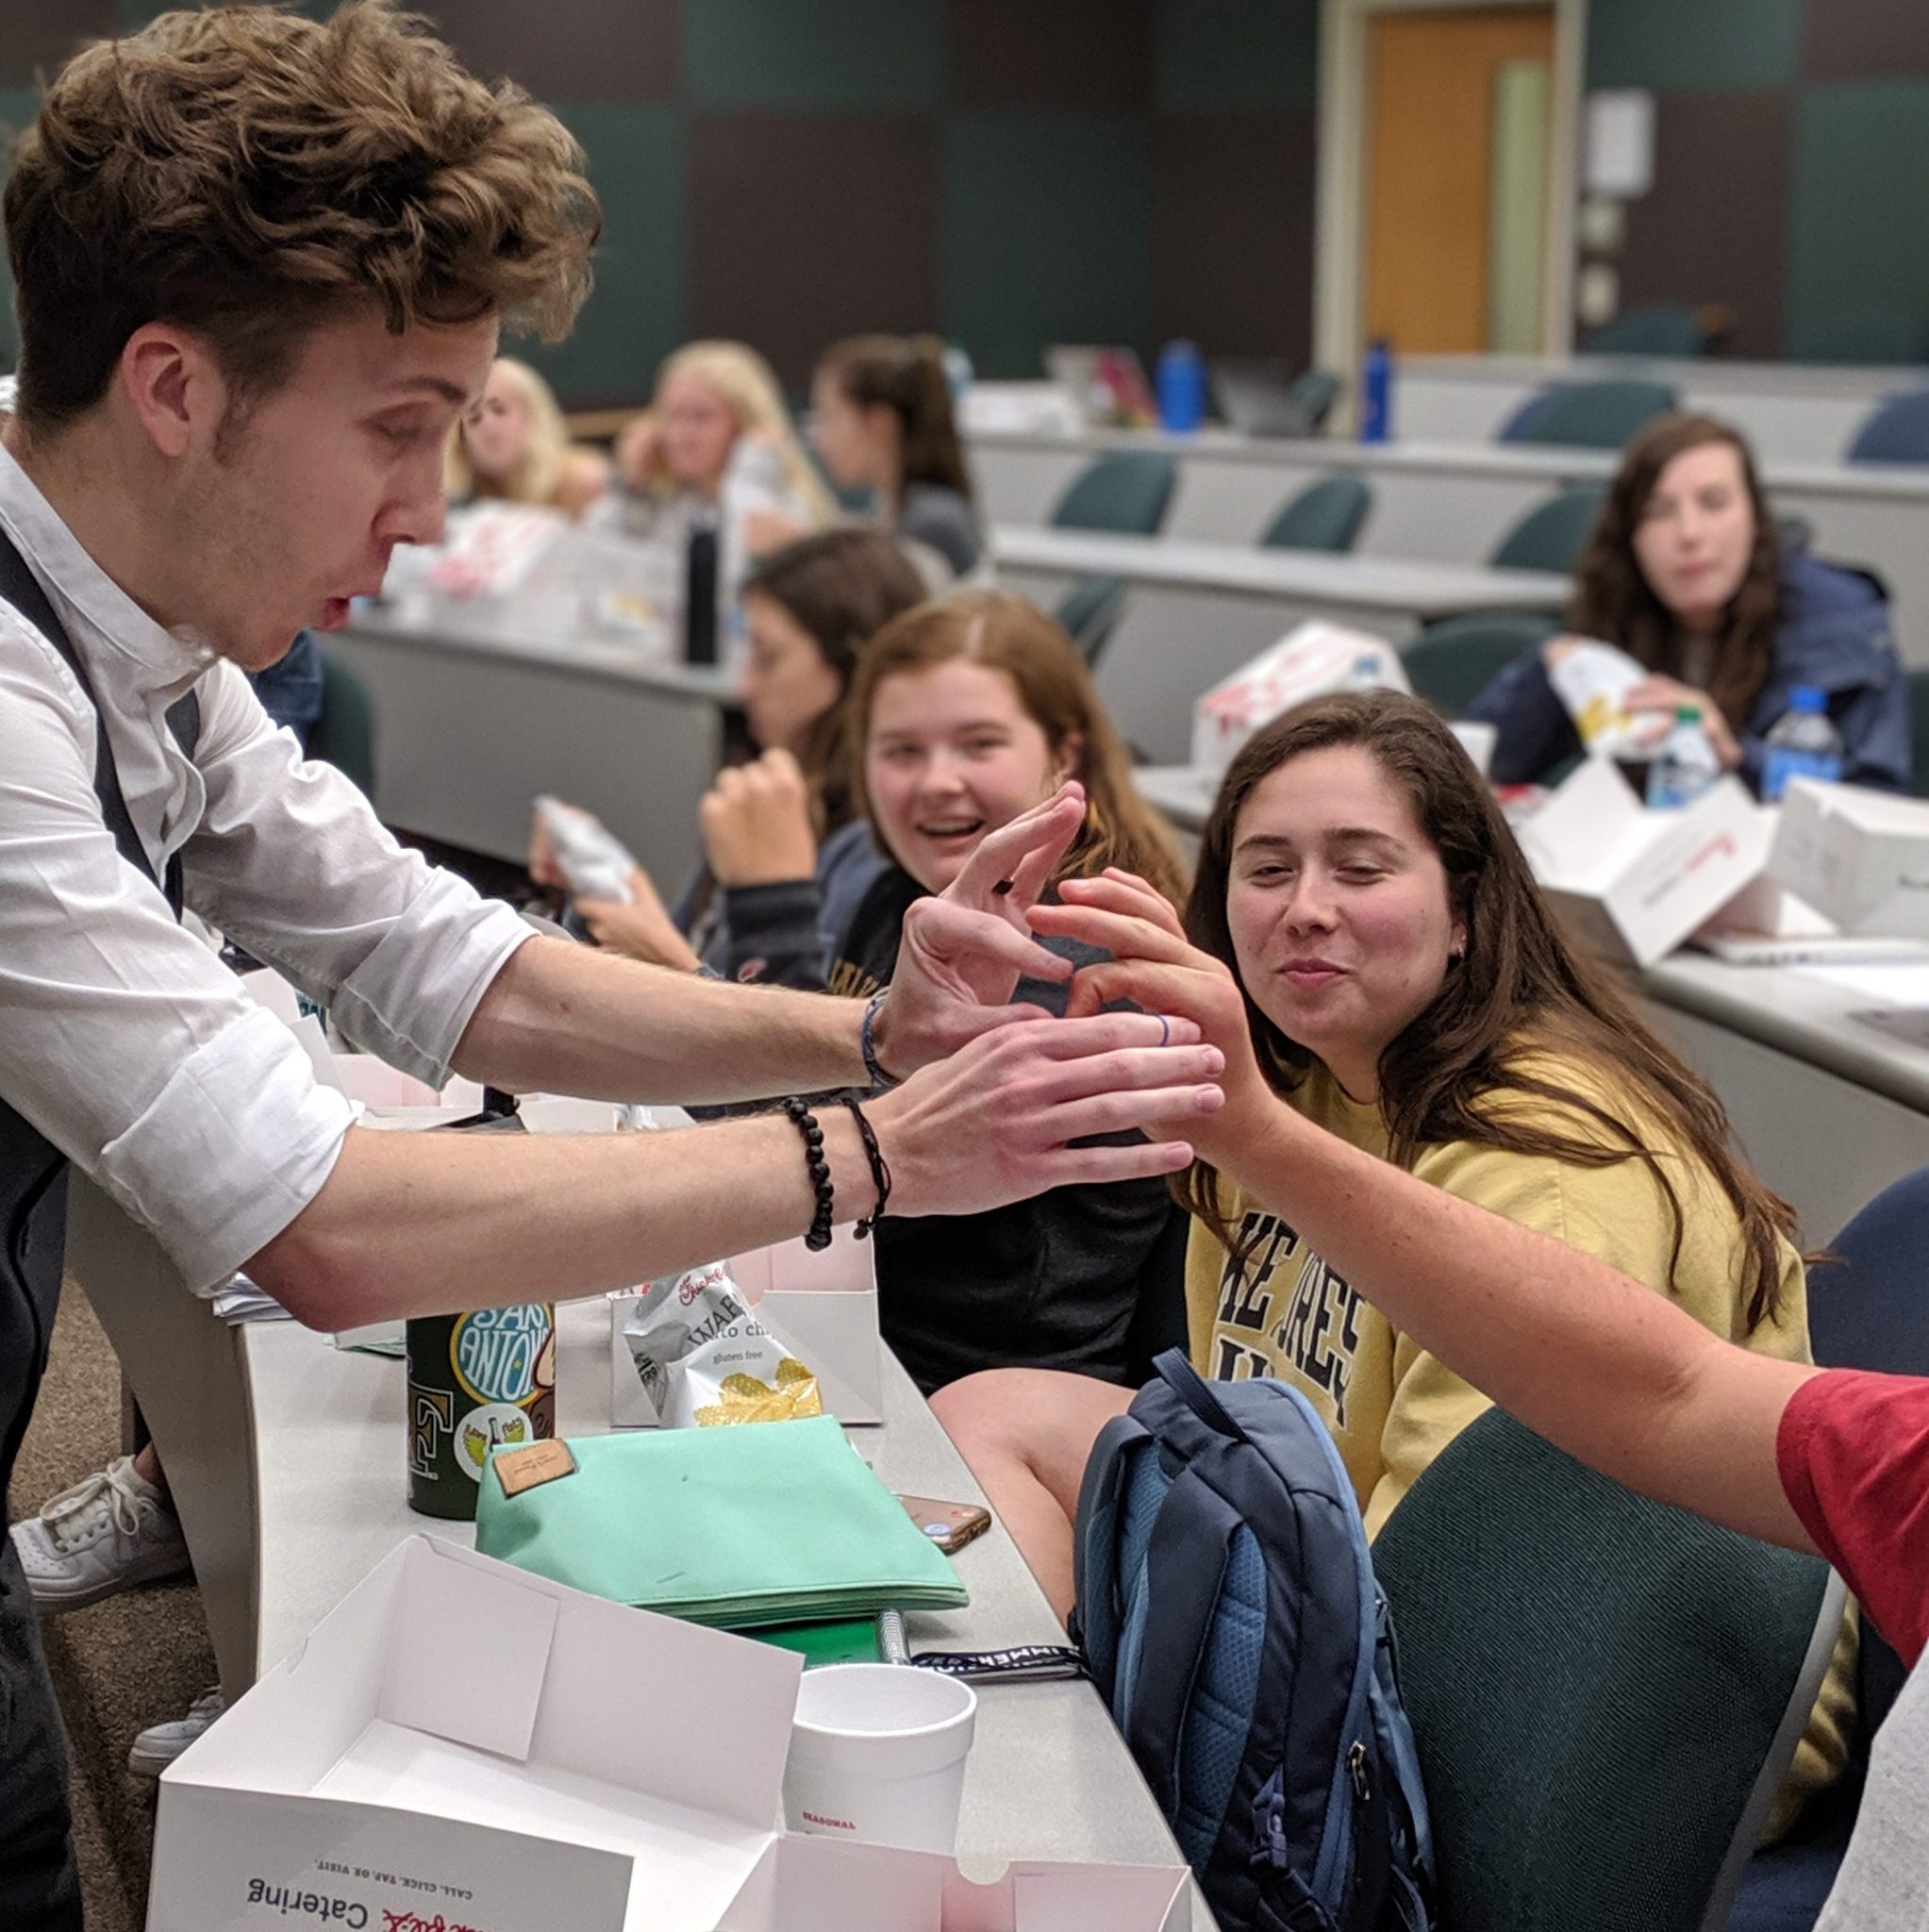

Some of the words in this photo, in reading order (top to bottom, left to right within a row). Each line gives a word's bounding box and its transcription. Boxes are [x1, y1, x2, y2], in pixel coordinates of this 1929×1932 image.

[745, 1320, 769, 1337] ch
[713, 1352, 743, 1365] gluten
[745, 1350, 763, 1360] free
[354, 1868, 371, 1879] OR
[247, 1878, 369, 1930] Catering
